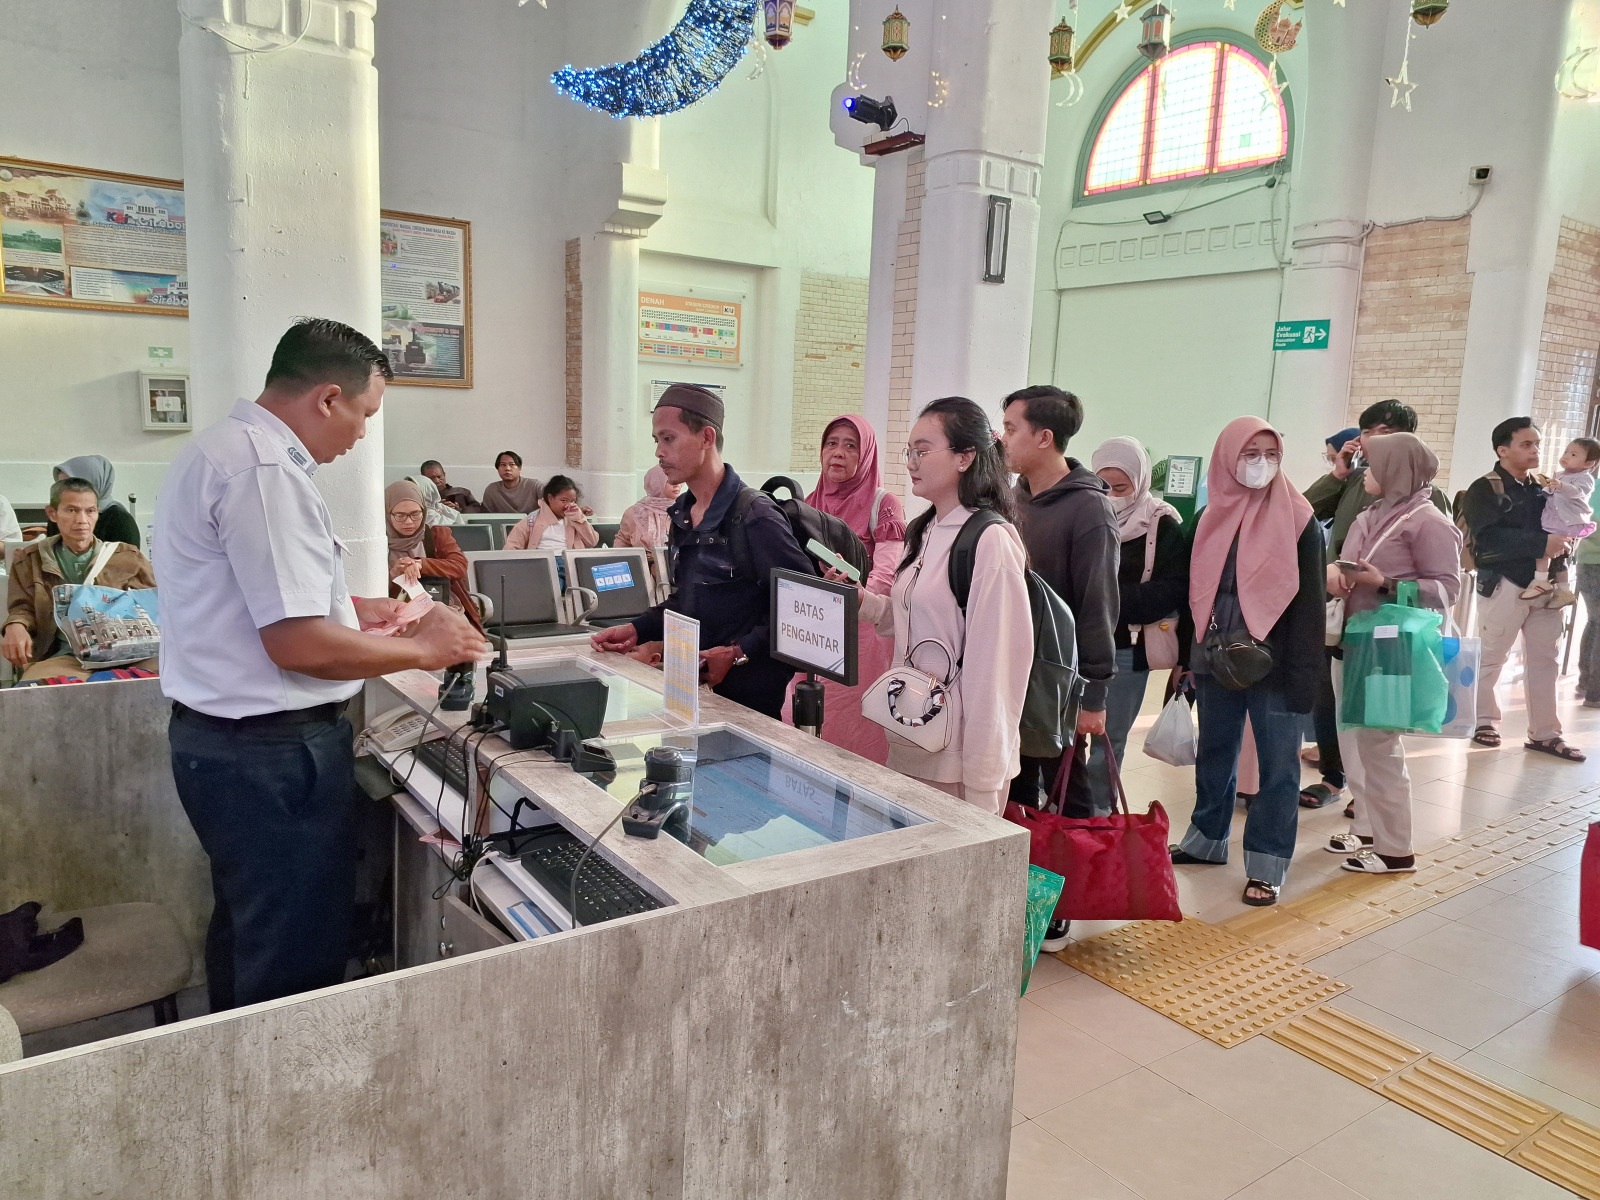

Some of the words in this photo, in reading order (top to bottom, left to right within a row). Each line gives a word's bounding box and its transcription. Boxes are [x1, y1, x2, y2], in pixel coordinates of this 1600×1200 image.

[641, 297, 665, 306] DENAH
[794, 600, 824, 621] BATAS
[781, 622, 840, 654] PENGANTAR
